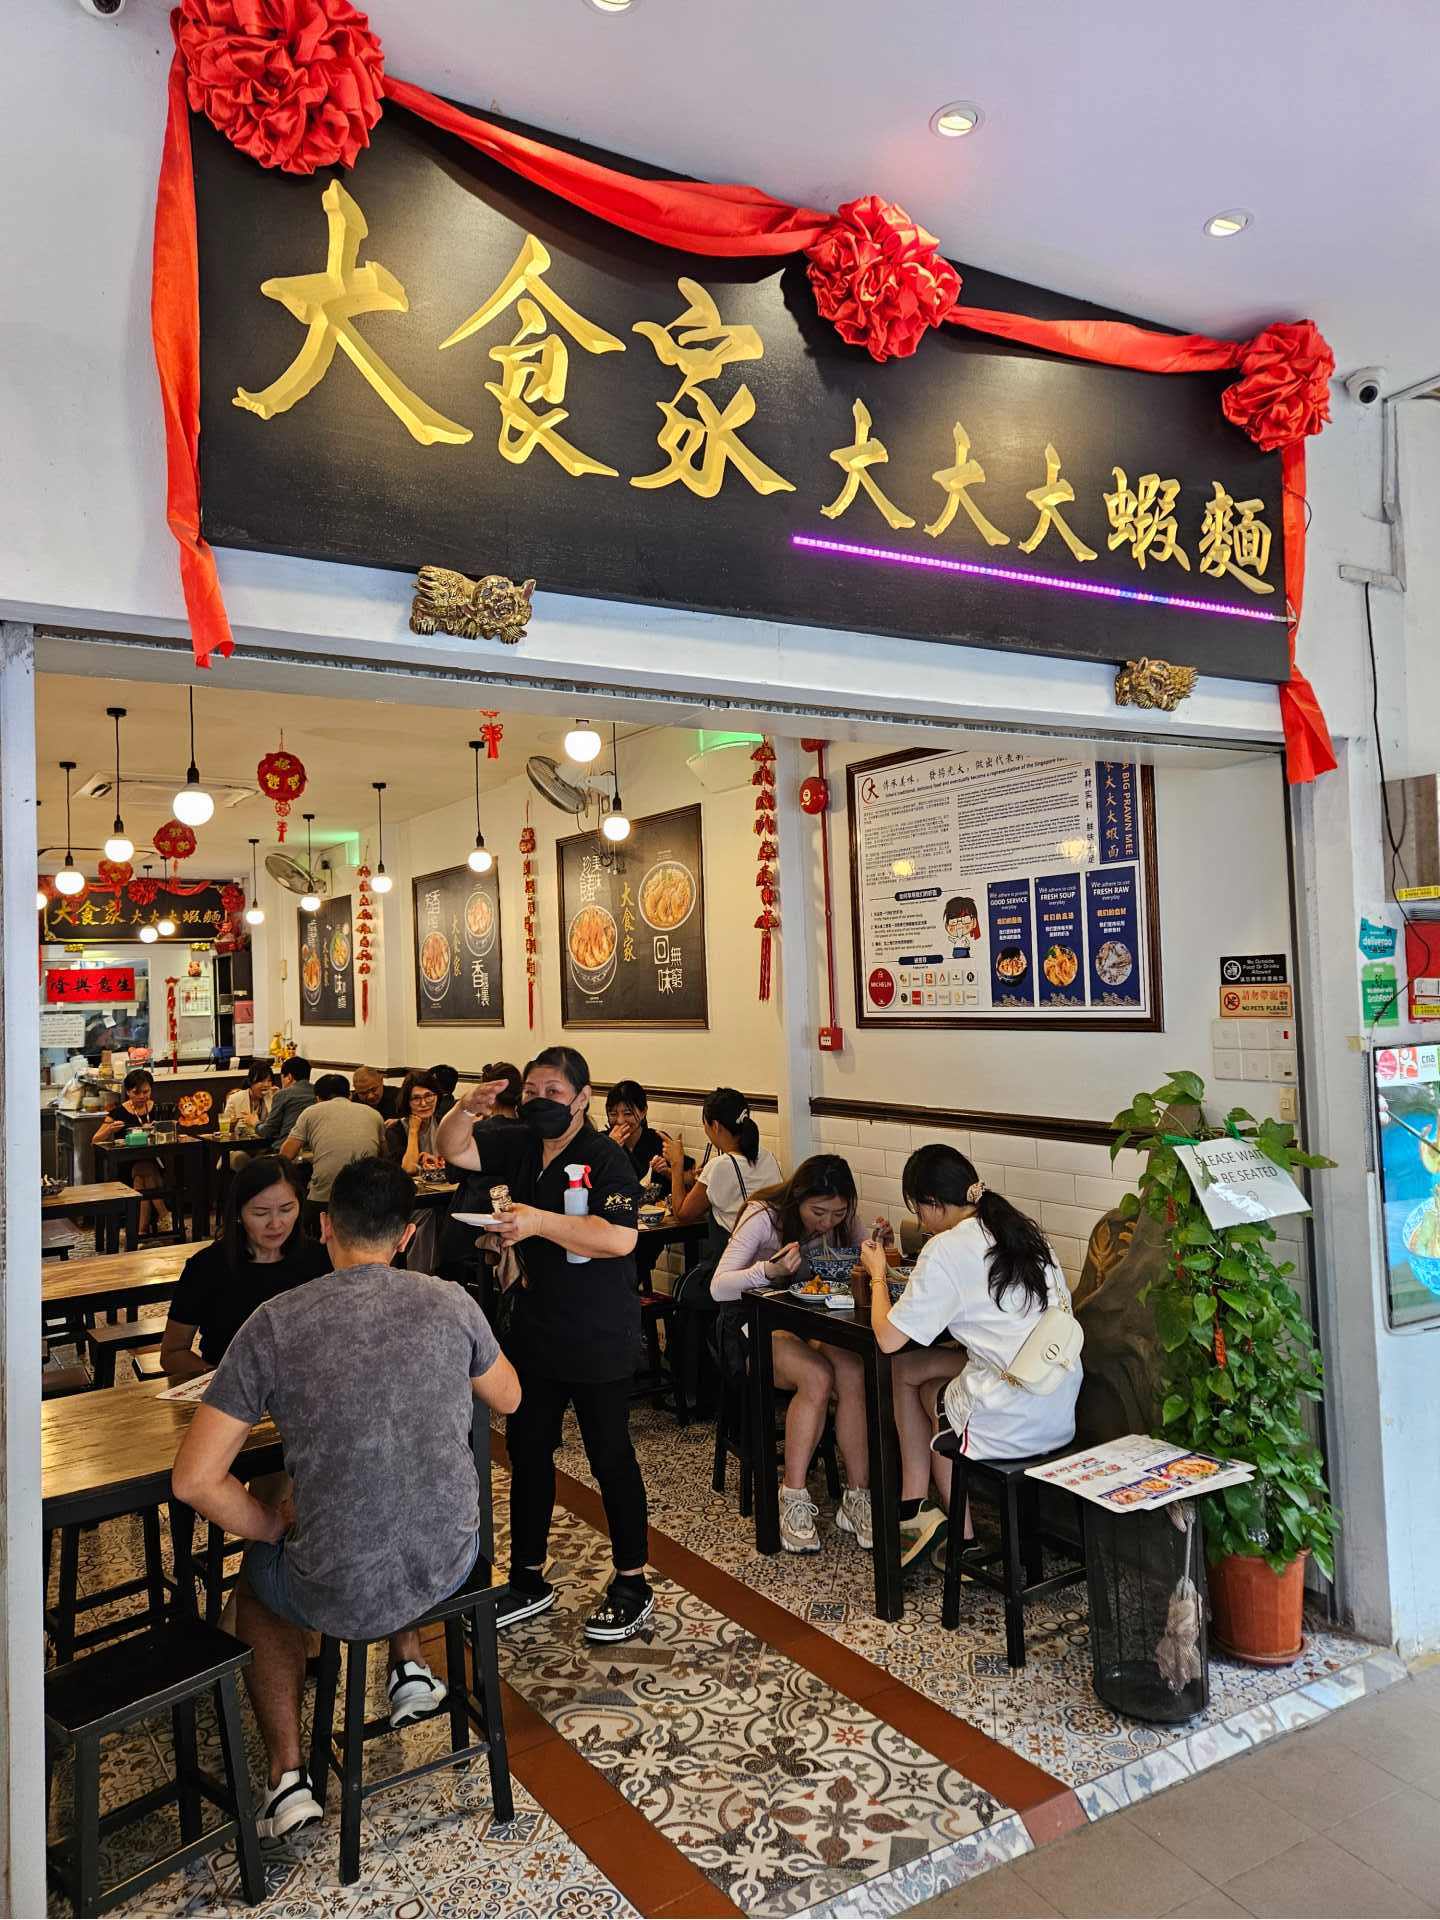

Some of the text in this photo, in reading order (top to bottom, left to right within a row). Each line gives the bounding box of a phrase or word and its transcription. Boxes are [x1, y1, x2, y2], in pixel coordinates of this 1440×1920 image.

[232, 178, 1275, 594] 大食家 大大大蝦麵
[989, 766, 1020, 777] representative
[1034, 758, 1056, 767] Singapore
[1122, 772, 1130, 790] BIG
[1122, 793, 1133, 831] PRAWN
[1125, 834, 1134, 856] MEE
[1040, 891, 1076, 901] FRESH SOUP
[1093, 886, 1130, 896] FRESH RAW
[990, 896, 1028, 906] GOOD SERVICE
[620, 881, 637, 962] 大食家
[1362, 936, 1392, 946] deliveroo
[1421, 1054, 1436, 1064] cna
[1194, 1152, 1235, 1168] PLEASE
[1220, 1172, 1237, 1184] BE
[1237, 1166, 1279, 1182] SEATED
